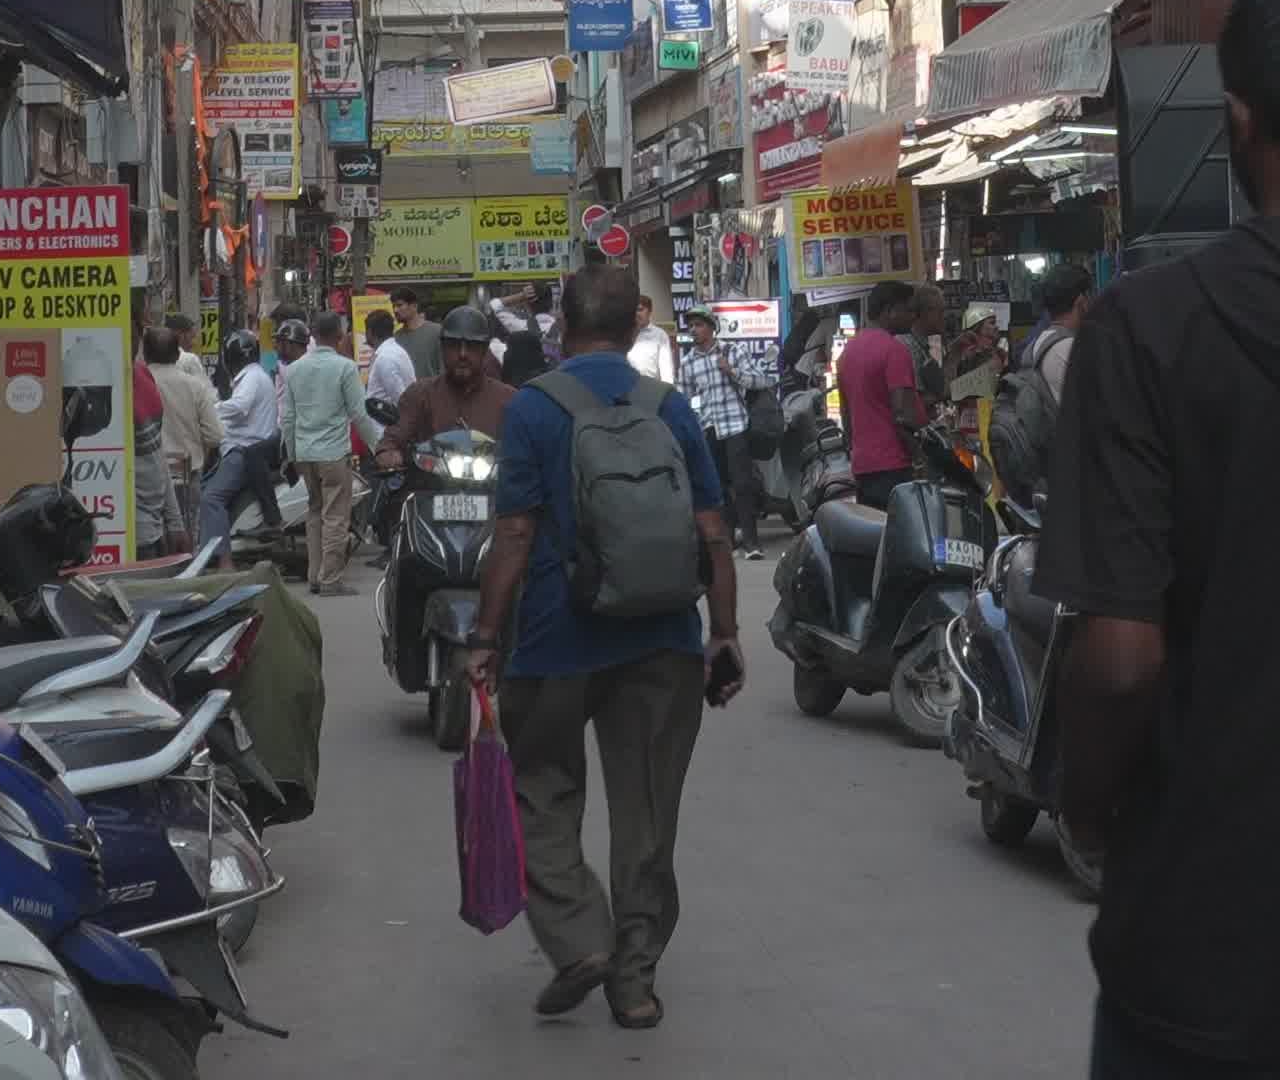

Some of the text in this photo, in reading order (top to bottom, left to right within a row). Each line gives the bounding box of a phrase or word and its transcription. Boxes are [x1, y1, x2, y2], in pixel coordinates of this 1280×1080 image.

[663, 47, 696, 62] MIVI
[248, 87, 292, 98] SERVICE
[806, 191, 897, 215] MOBILE
[383, 226, 436, 237] MOBILE
[803, 212, 906, 235] SERVICE
[26, 236, 35, 251] &
[38, 234, 120, 250] ELECTRONICS
[20, 264, 118, 290] CAMERA
[22, 296, 36, 319] &
[42, 294, 121, 319] DESKTOP
[12, 896, 54, 919] YAMAHA
